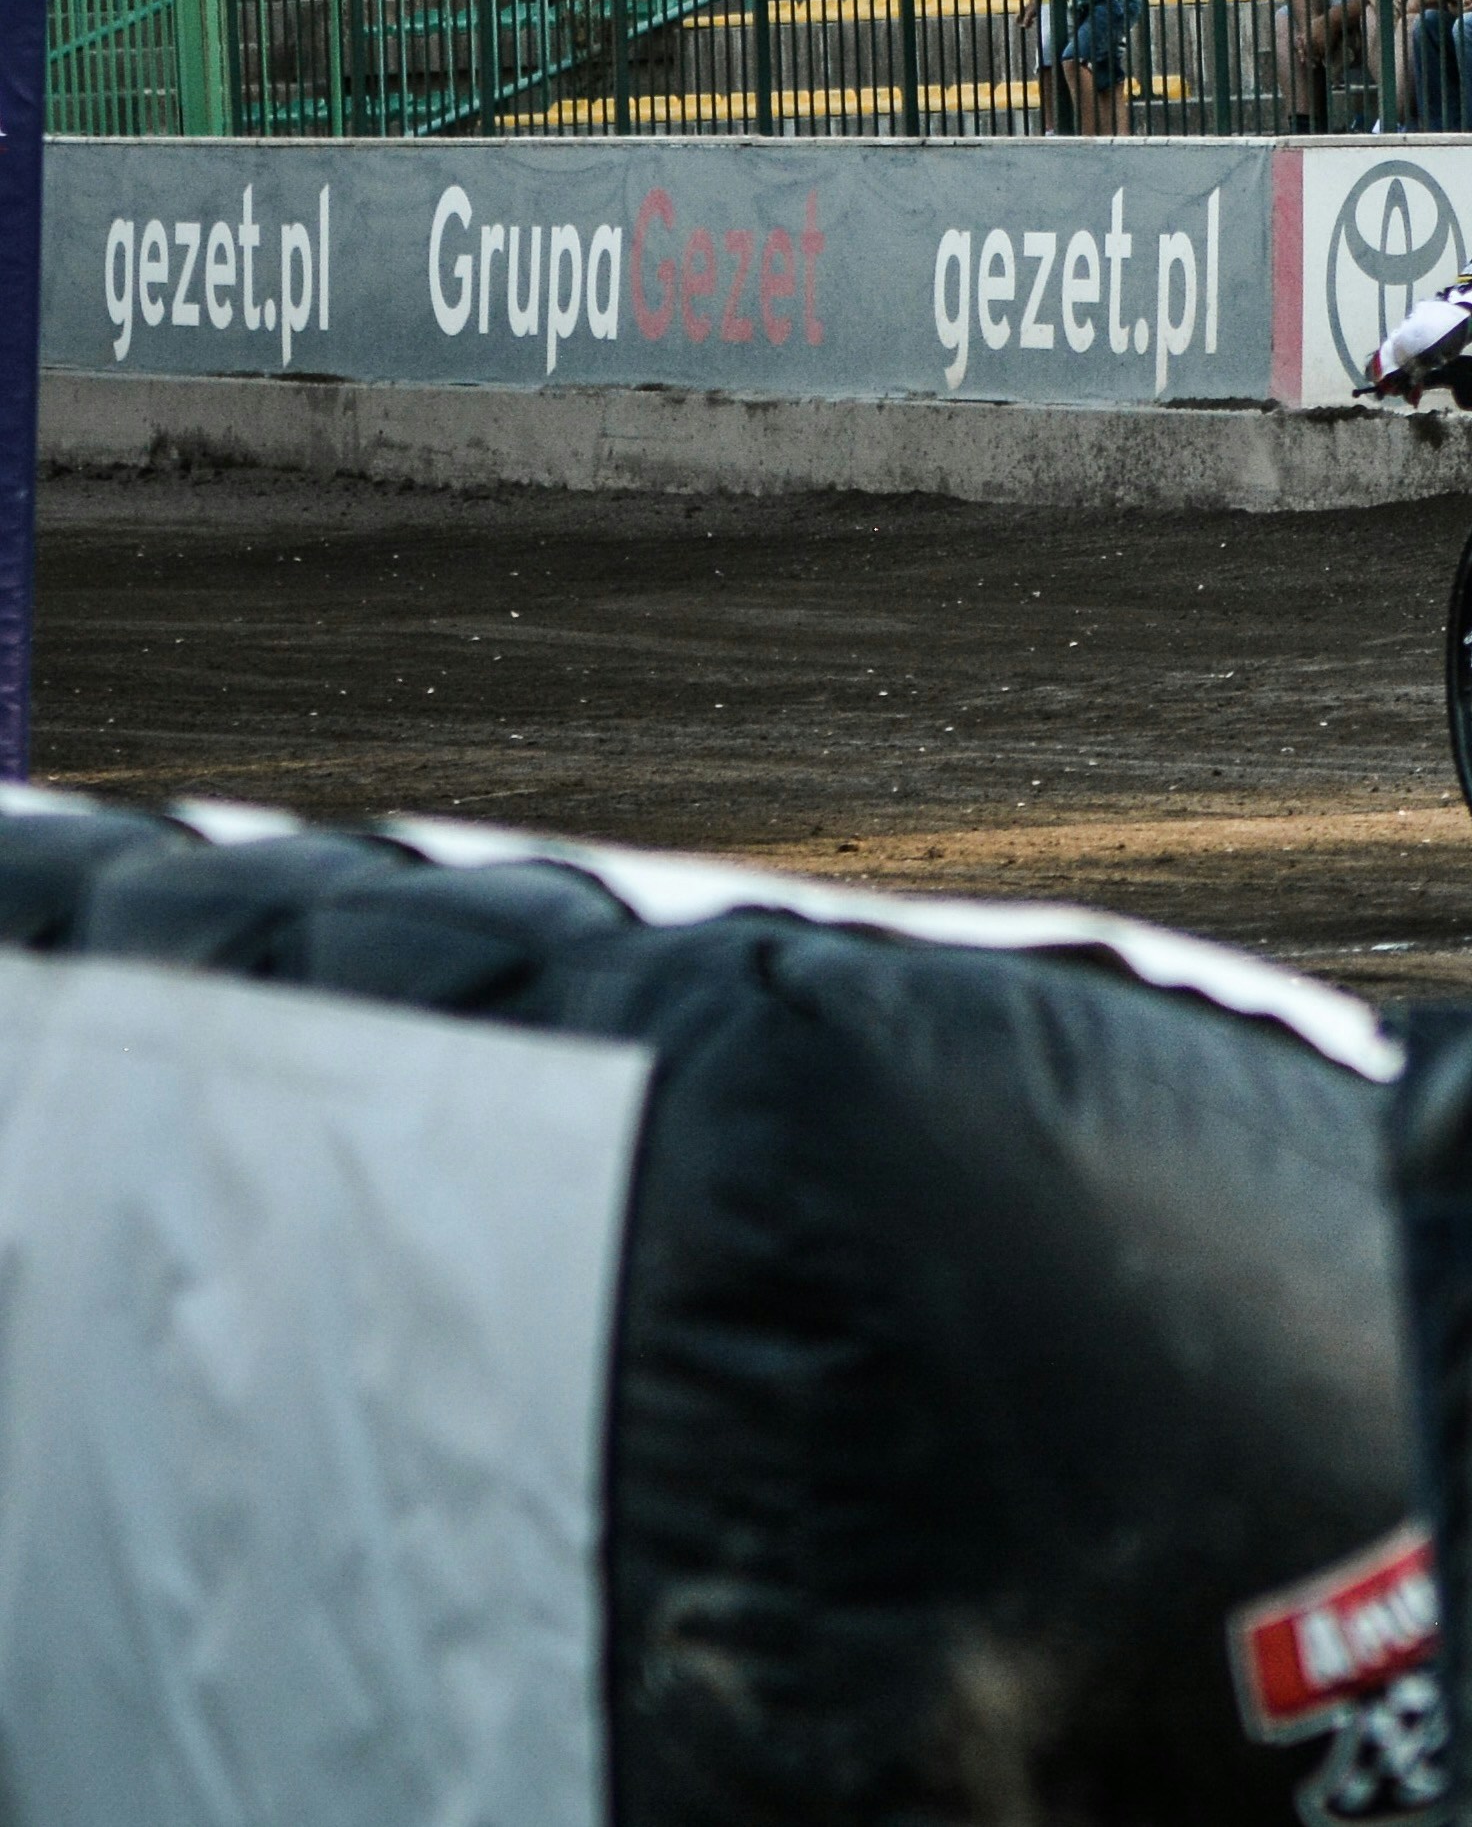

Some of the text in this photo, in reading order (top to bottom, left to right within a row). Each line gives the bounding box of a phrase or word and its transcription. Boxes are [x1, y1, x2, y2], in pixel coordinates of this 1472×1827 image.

[105, 182, 331, 364] gezet.pl
[429, 184, 825, 376] Grupa Gezet
[932, 186, 1220, 399] gezet.pl
